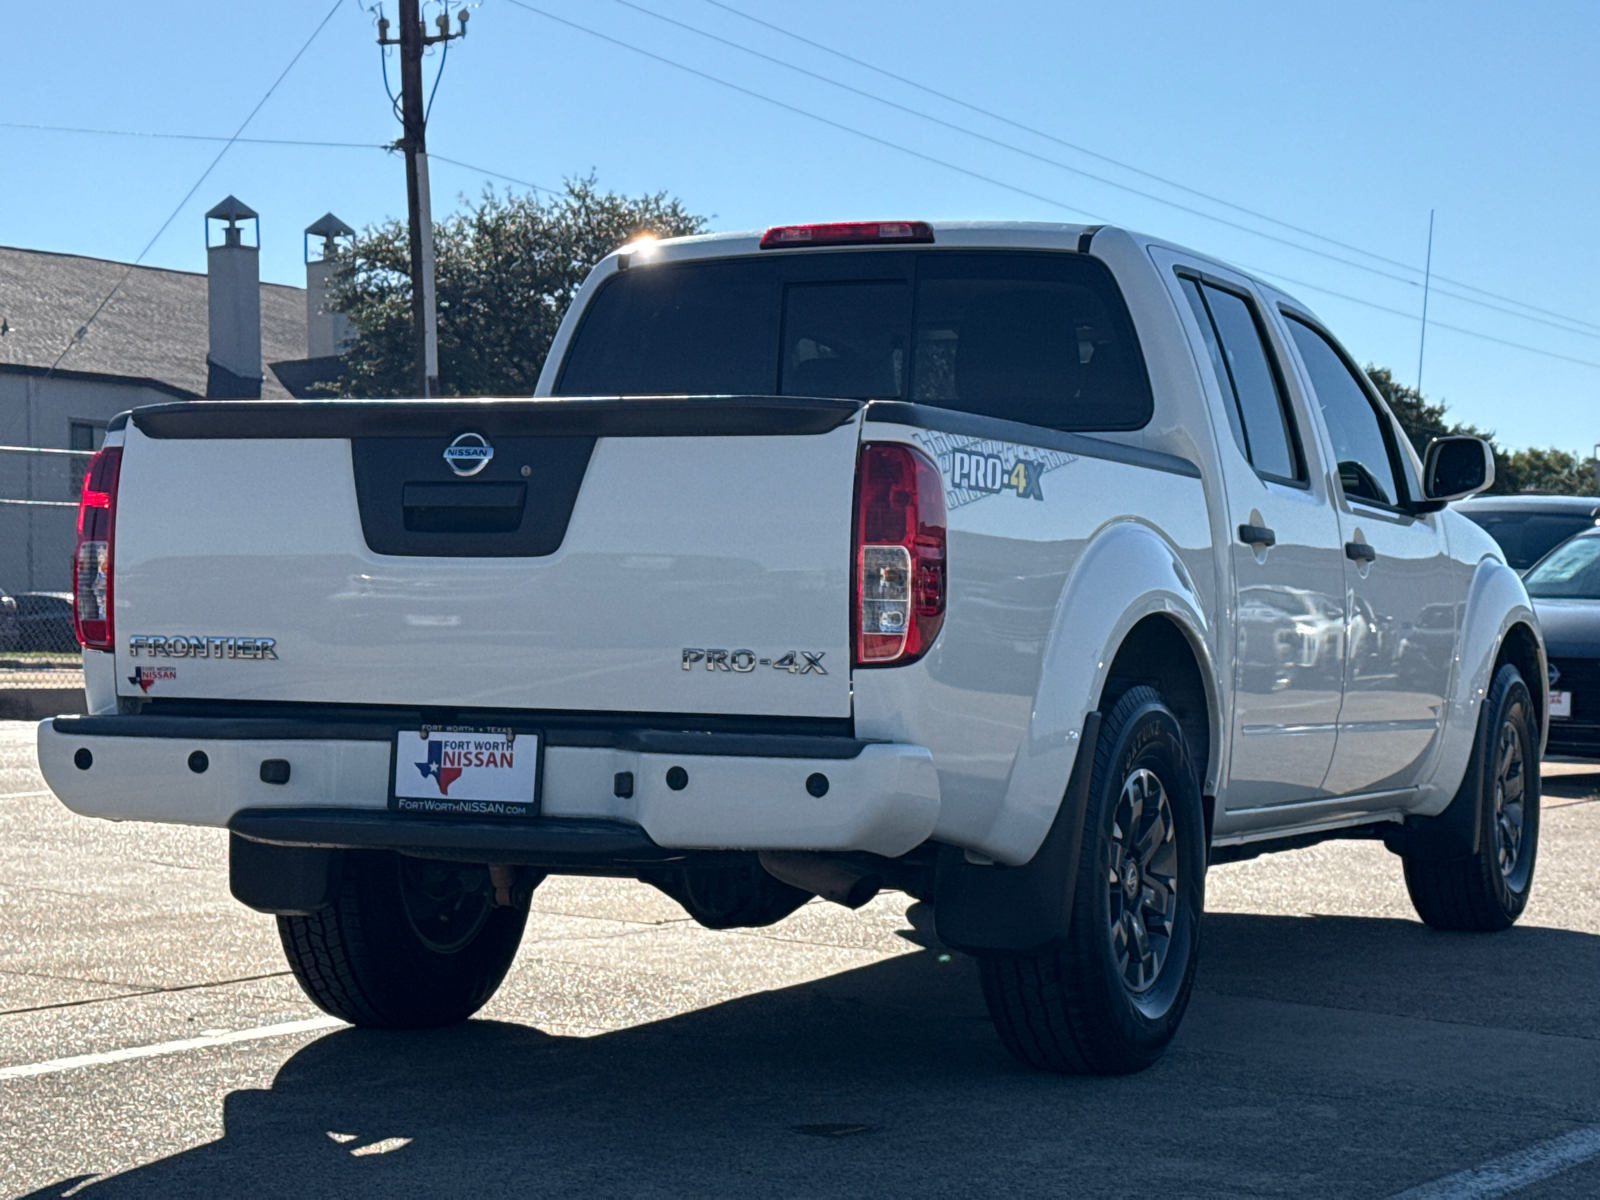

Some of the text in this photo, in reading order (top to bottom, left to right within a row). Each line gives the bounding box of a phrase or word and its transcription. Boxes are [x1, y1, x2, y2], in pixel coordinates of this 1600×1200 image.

[447, 449, 487, 457] NISSAN
[952, 448, 1045, 501] PRO-4X
[129, 635, 279, 660] FRONTIER
[681, 648, 828, 675] PRO-4X
[142, 672, 176, 680] NISSAN
[444, 741, 514, 751] FORT WORTH
[443, 751, 513, 768] NISSAN
